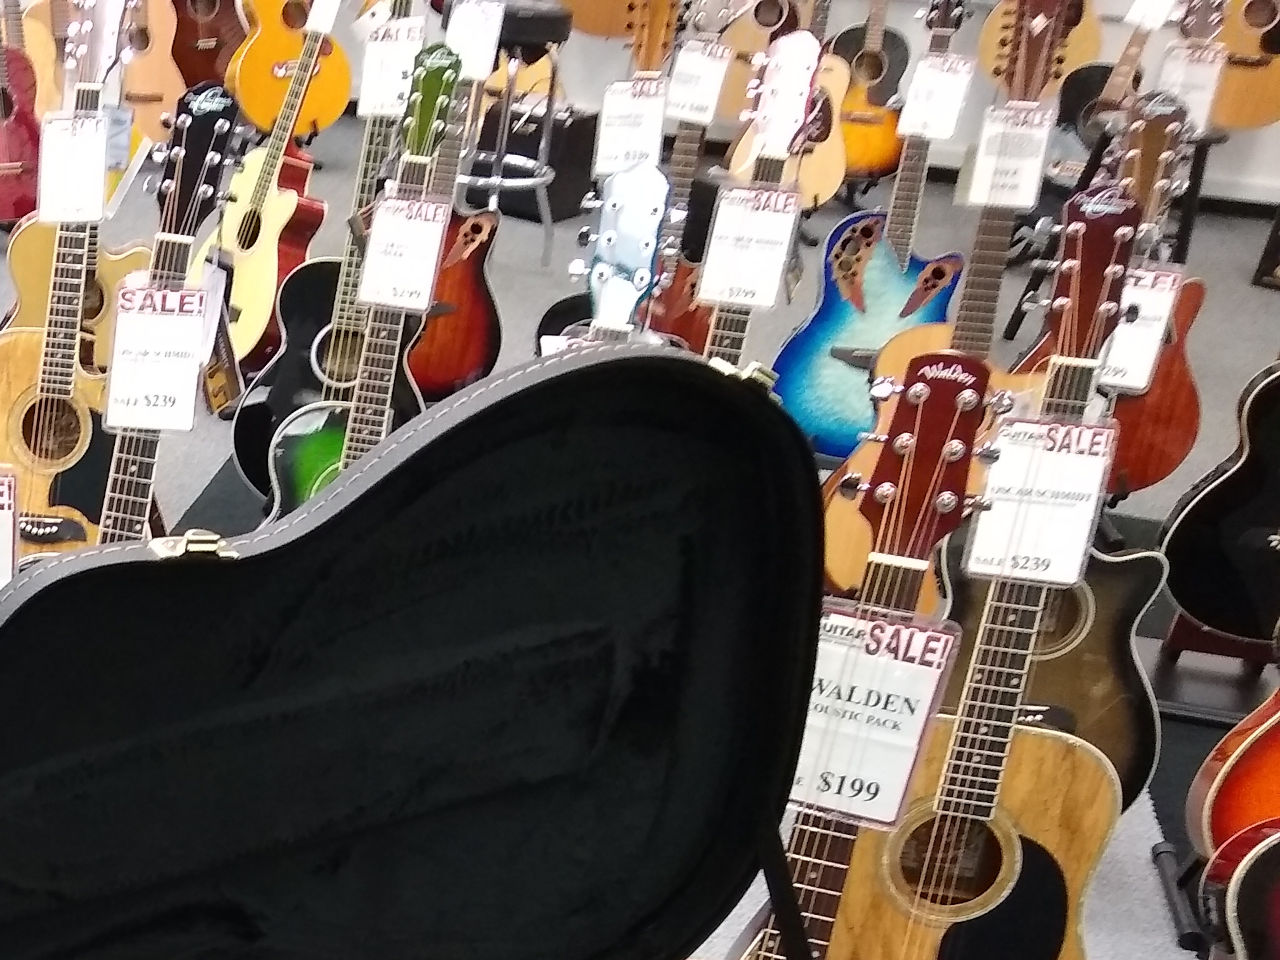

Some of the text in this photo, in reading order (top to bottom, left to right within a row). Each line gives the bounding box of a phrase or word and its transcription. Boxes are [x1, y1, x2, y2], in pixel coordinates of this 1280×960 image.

[119, 288, 205, 315] SALE!
[917, 361, 977, 387] Walden
[143, 393, 177, 408] $239
[1045, 426, 1111, 457] SALE!
[1010, 554, 1052, 573] $239
[821, 622, 866, 640] UITAR
[864, 622, 951, 671] SALE!
[809, 702, 903, 732] OUSTIC PACK
[816, 770, 881, 803] $199
